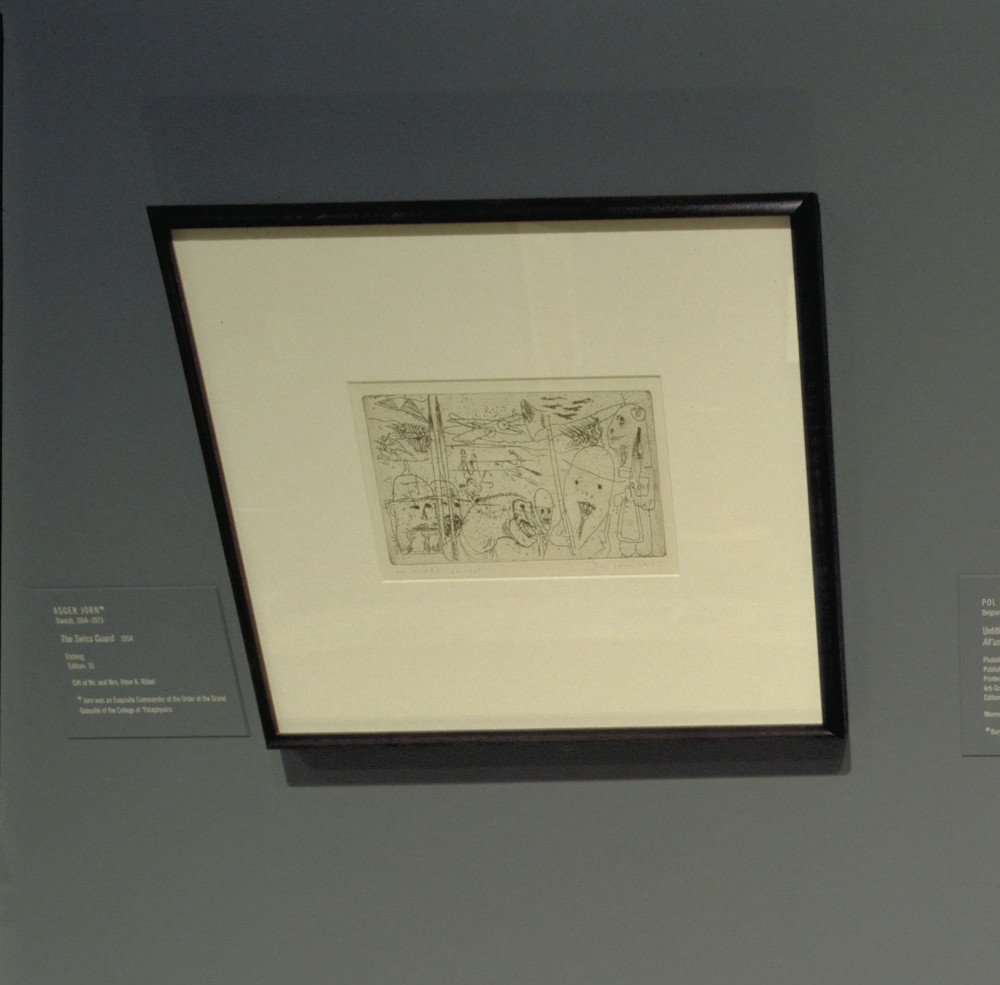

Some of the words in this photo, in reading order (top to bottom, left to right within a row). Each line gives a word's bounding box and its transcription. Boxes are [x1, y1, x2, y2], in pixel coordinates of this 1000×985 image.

[982, 598, 996, 606] POL
[53, 606, 78, 615] ASGER
[60, 634, 73, 643] The
[74, 634, 94, 643] Swiss
[94, 634, 115, 643] Guard
[65, 653, 85, 661] Etching
[201, 695, 210, 703] the
